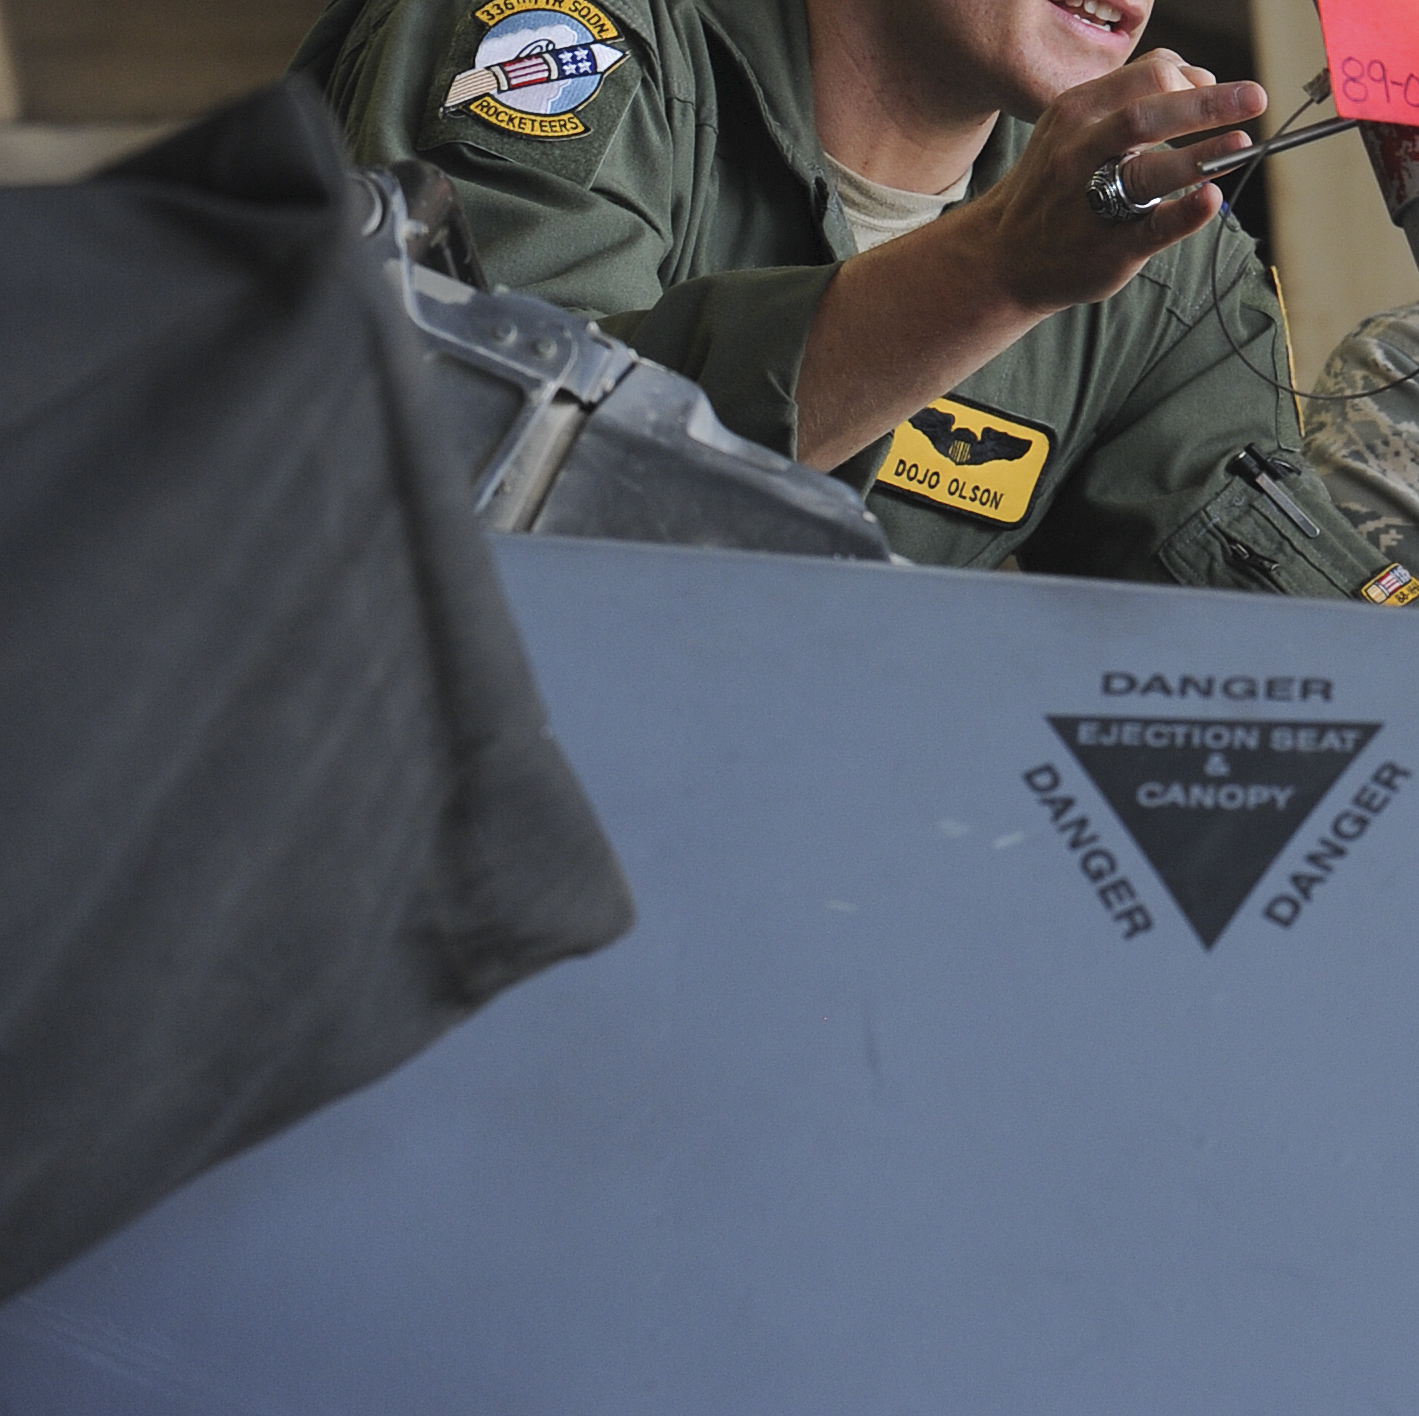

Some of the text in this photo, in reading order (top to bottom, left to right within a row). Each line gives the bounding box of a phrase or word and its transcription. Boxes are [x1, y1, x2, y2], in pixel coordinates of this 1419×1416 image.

[475, 99, 579, 133] ROCKETEERS
[894, 458, 1004, 510] DOJO OLSON
[1102, 671, 1335, 702] DANGER
[1076, 722, 1361, 753] EJECTION SEAT
[1203, 752, 1230, 777] &
[1136, 782, 1297, 810] CANOPY
[1022, 762, 1154, 940] DANGER
[1263, 761, 1412, 930] DANGER
